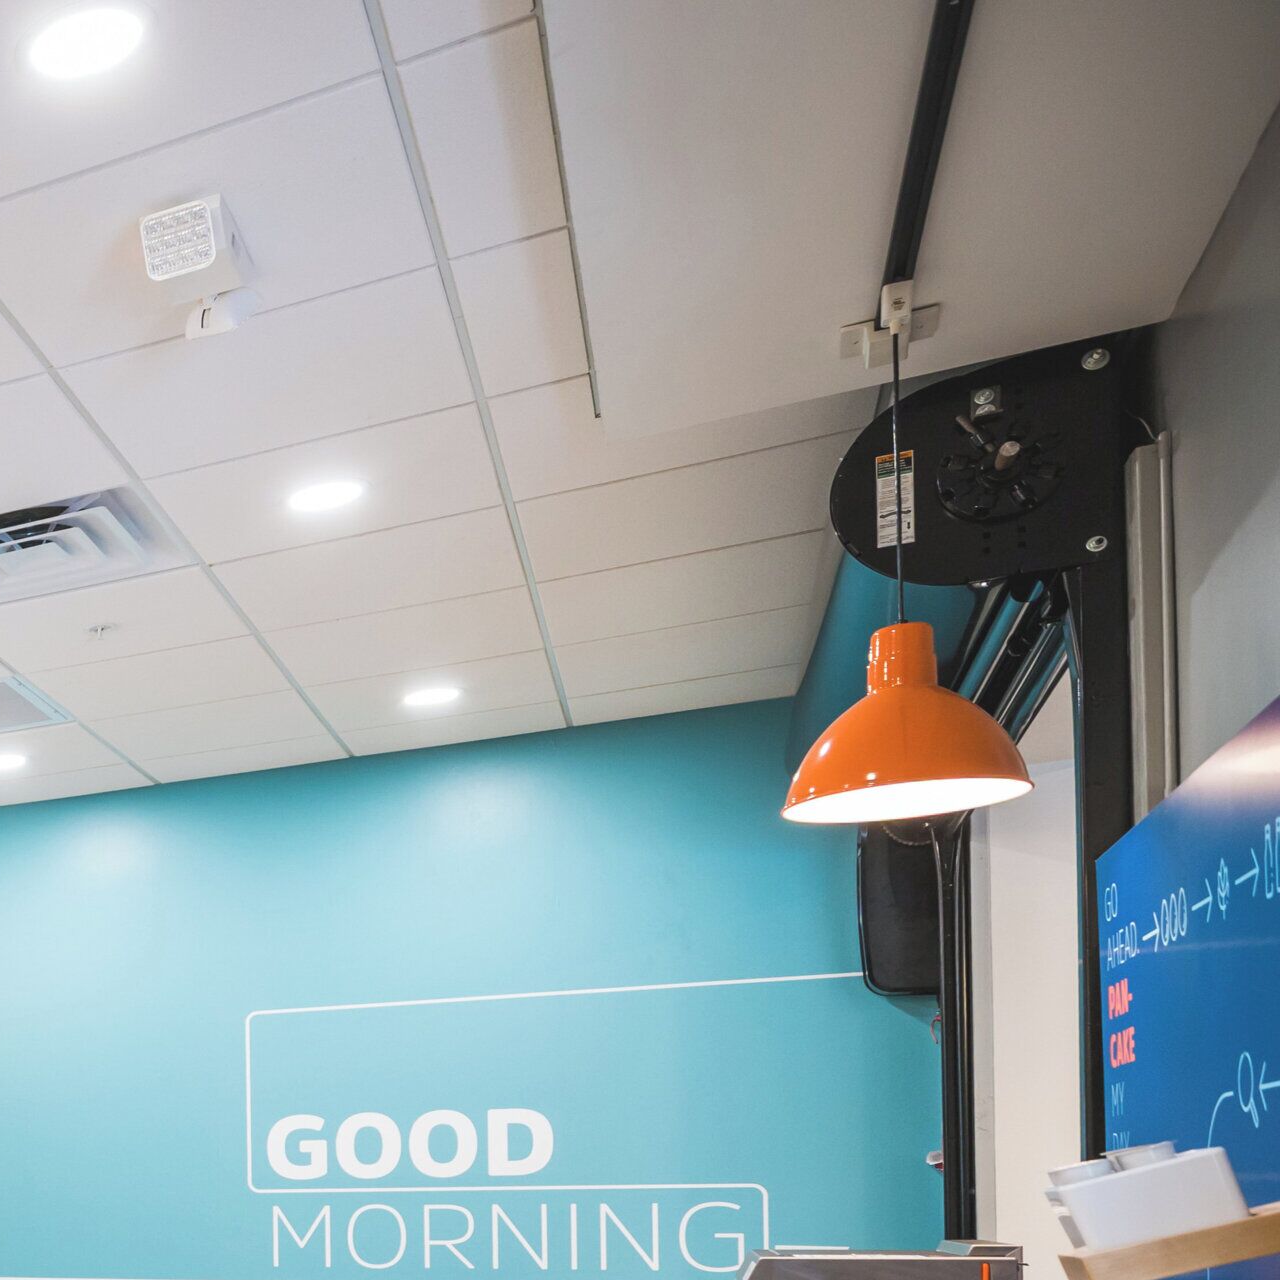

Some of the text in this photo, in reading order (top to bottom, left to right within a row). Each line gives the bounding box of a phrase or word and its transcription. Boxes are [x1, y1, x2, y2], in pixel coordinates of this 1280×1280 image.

[1104, 883, 1118, 922] GO
[1108, 978, 1133, 1020] PAN-
[1110, 1026, 1136, 1069] CAKE
[1111, 1081, 1125, 1117] MY
[266, 1107, 555, 1181] GOOD
[272, 1200, 746, 1273] MORNING
